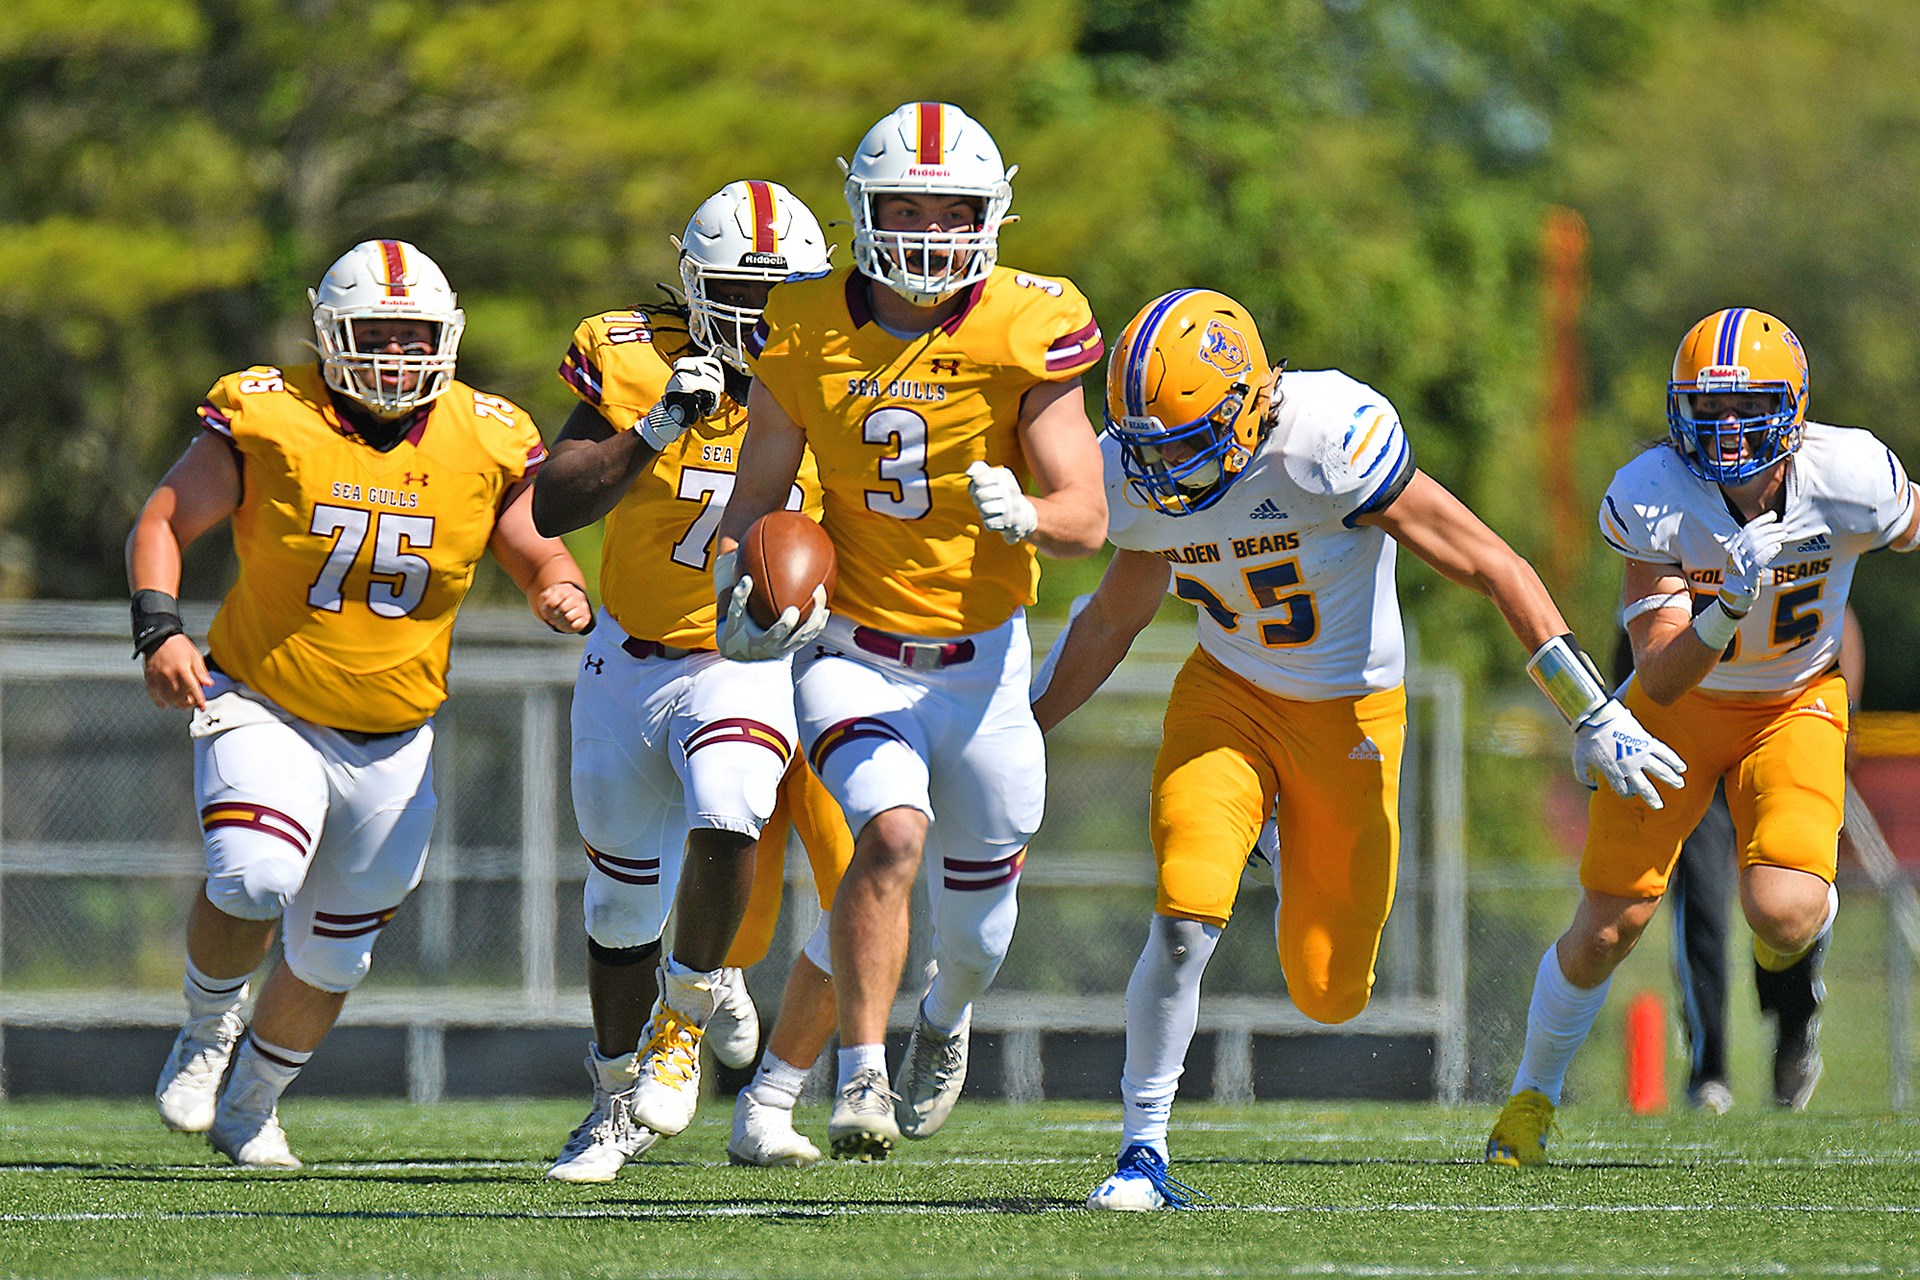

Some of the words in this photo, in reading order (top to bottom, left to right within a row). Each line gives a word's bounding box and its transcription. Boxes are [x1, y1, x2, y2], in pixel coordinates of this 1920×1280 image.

[1015, 273, 1063, 297] 3
[848, 378, 880, 397] SEA
[888, 380, 947, 401] GULLS
[472, 391, 514, 429] 75
[702, 445, 733, 463] SEA
[862, 406, 933, 521] 3
[332, 482, 361, 501] SEA
[368, 487, 418, 508] GULLS
[1250, 512, 1288, 520] adidas
[1232, 531, 1301, 559] BEARS
[306, 502, 435, 619] 75
[1772, 557, 1833, 586] BEARS
[1612, 731, 1649, 748] adidas
[1348, 751, 1384, 762] adidas
